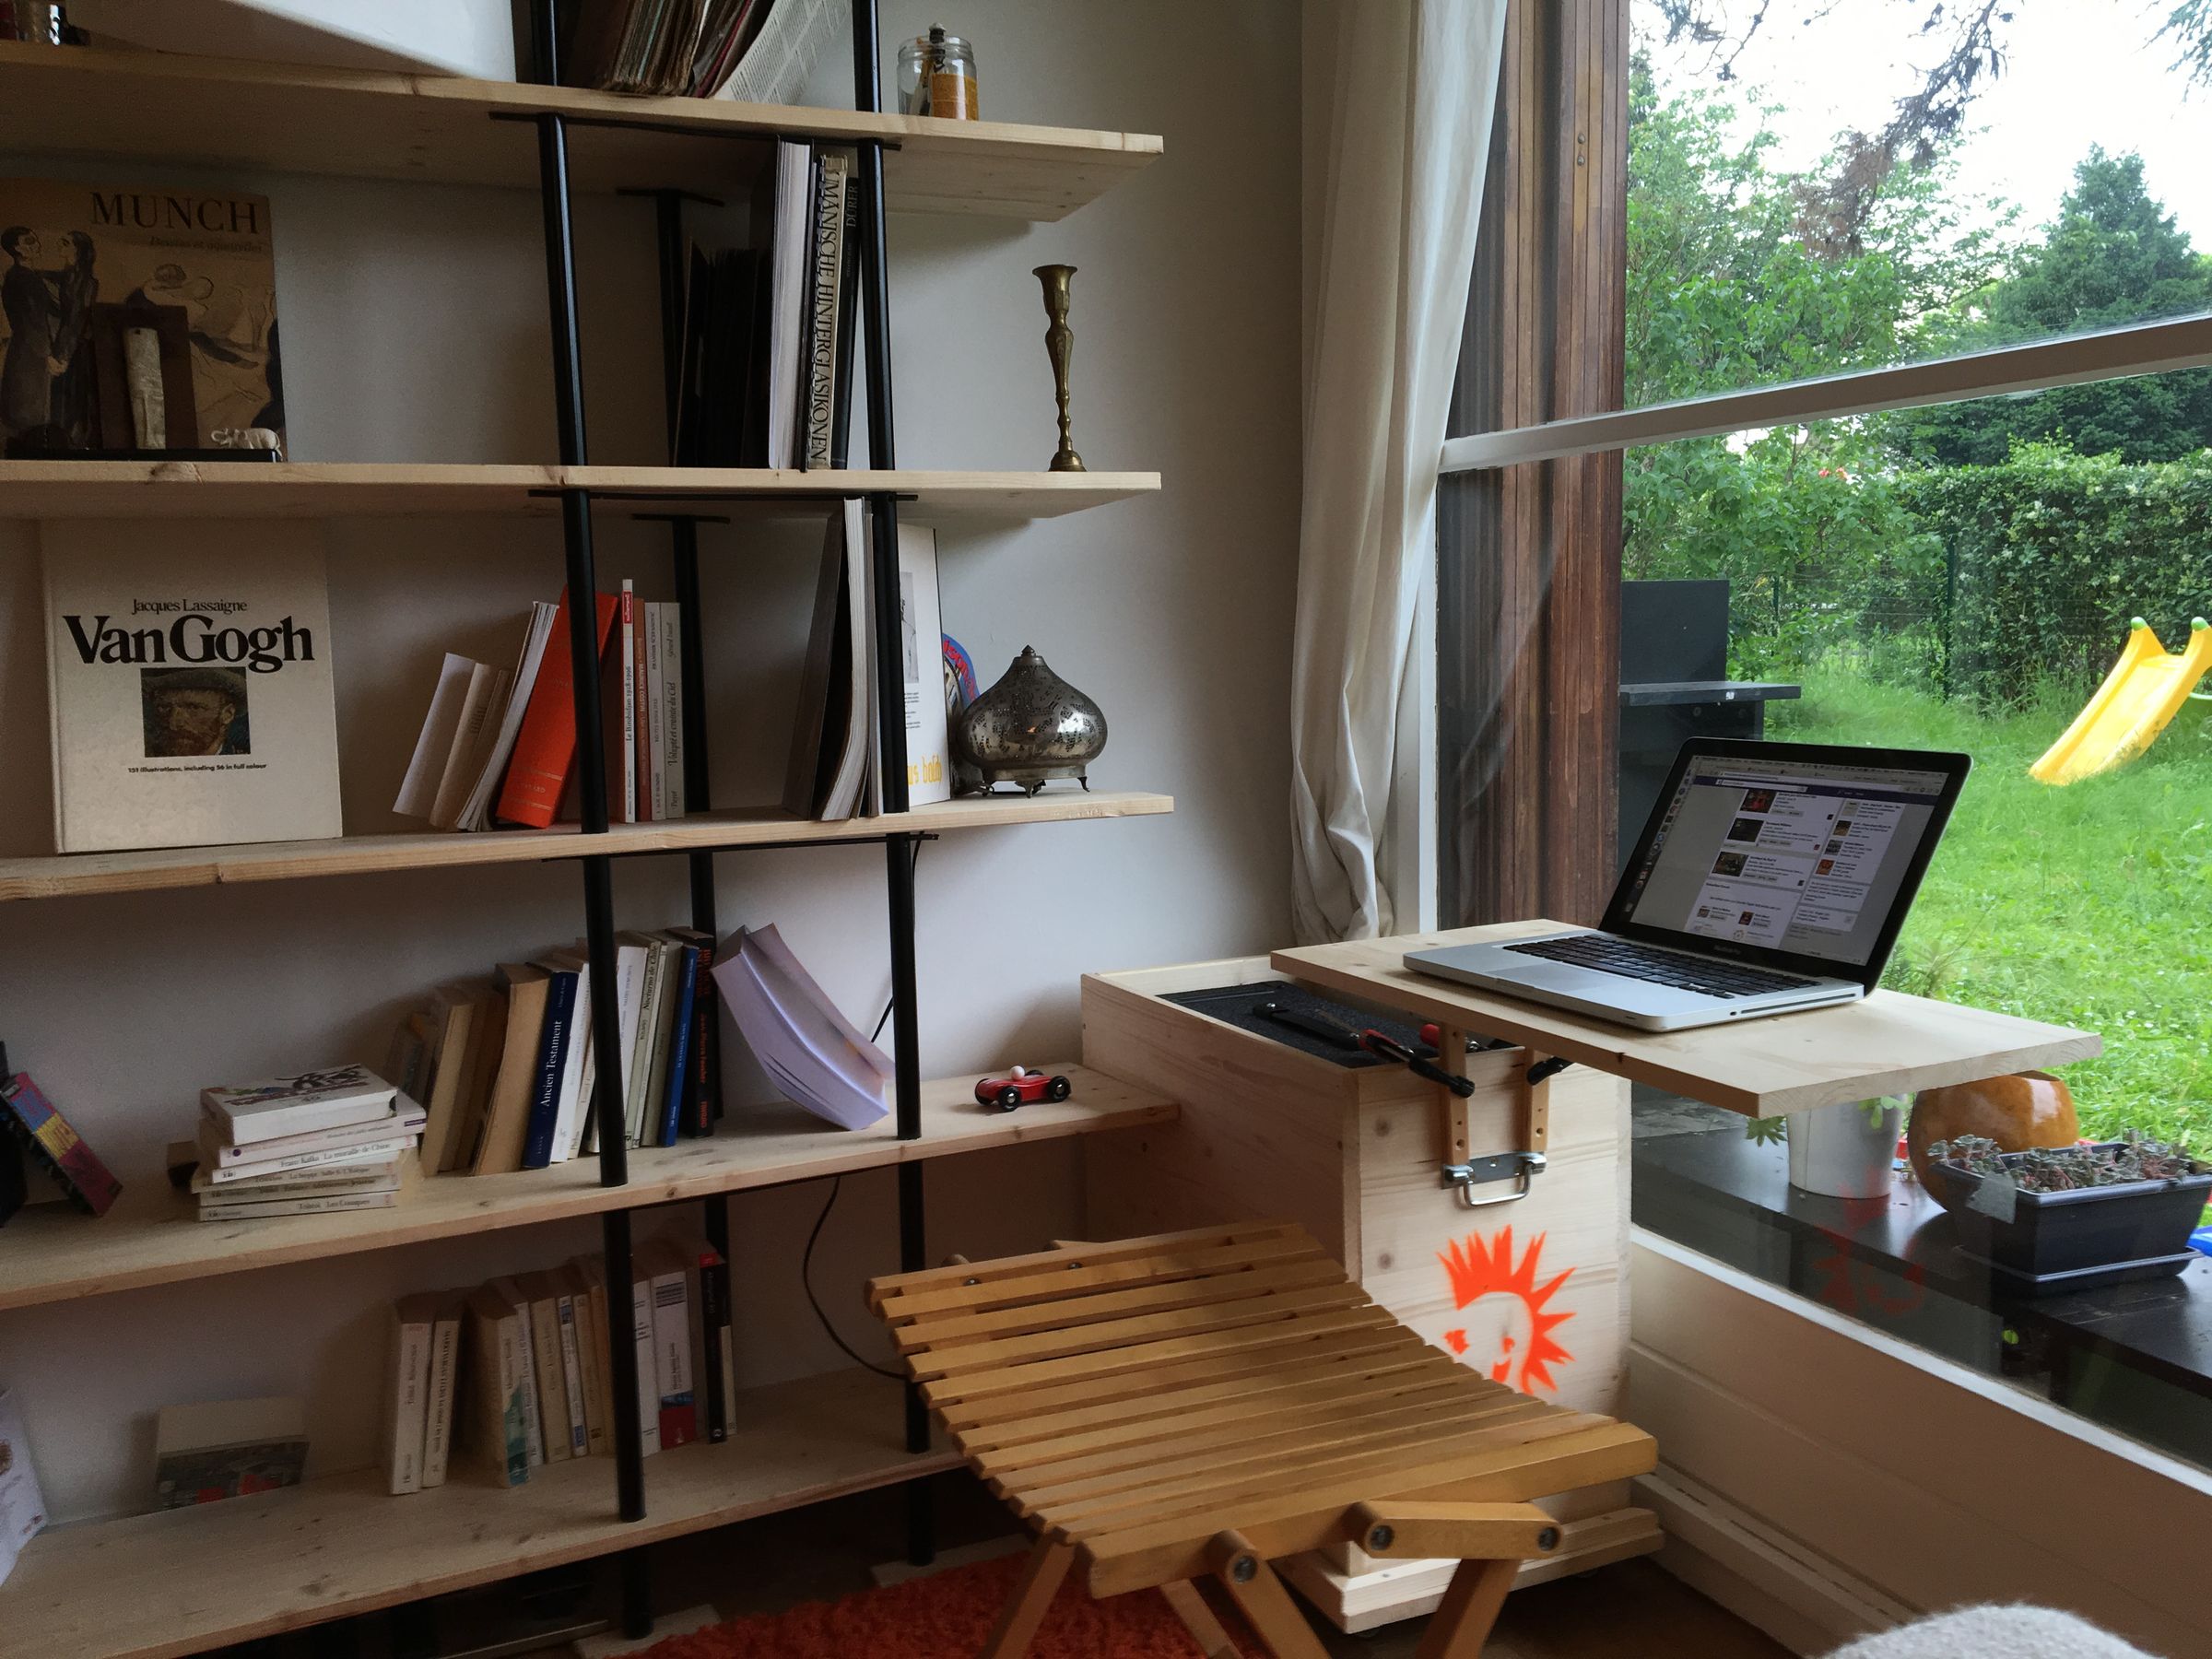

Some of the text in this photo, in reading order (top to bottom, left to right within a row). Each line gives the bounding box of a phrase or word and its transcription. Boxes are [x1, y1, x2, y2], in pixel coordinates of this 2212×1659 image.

[90, 192, 259, 234] MUNCH
[845, 185, 857, 228] DÜRER
[810, 284, 835, 462] HINTERGLASIKONEN
[132, 599, 248, 616] Jacques Lassaigne
[63, 614, 315, 674] Van Gogh
[666, 682, 677, 696] Ciel
[667, 696, 677, 706] du
[624, 698, 634, 733] Birobidjan
[625, 734, 633, 742] Le
[667, 738, 679, 766] Volupté
[183, 764, 215, 773] including
[216, 763, 224, 771] 56
[233, 762, 245, 771] full
[641, 945, 658, 1011] Nocturno de Chile
[544, 1019, 563, 1071] Testament
[539, 1073, 556, 1108] Ancien
